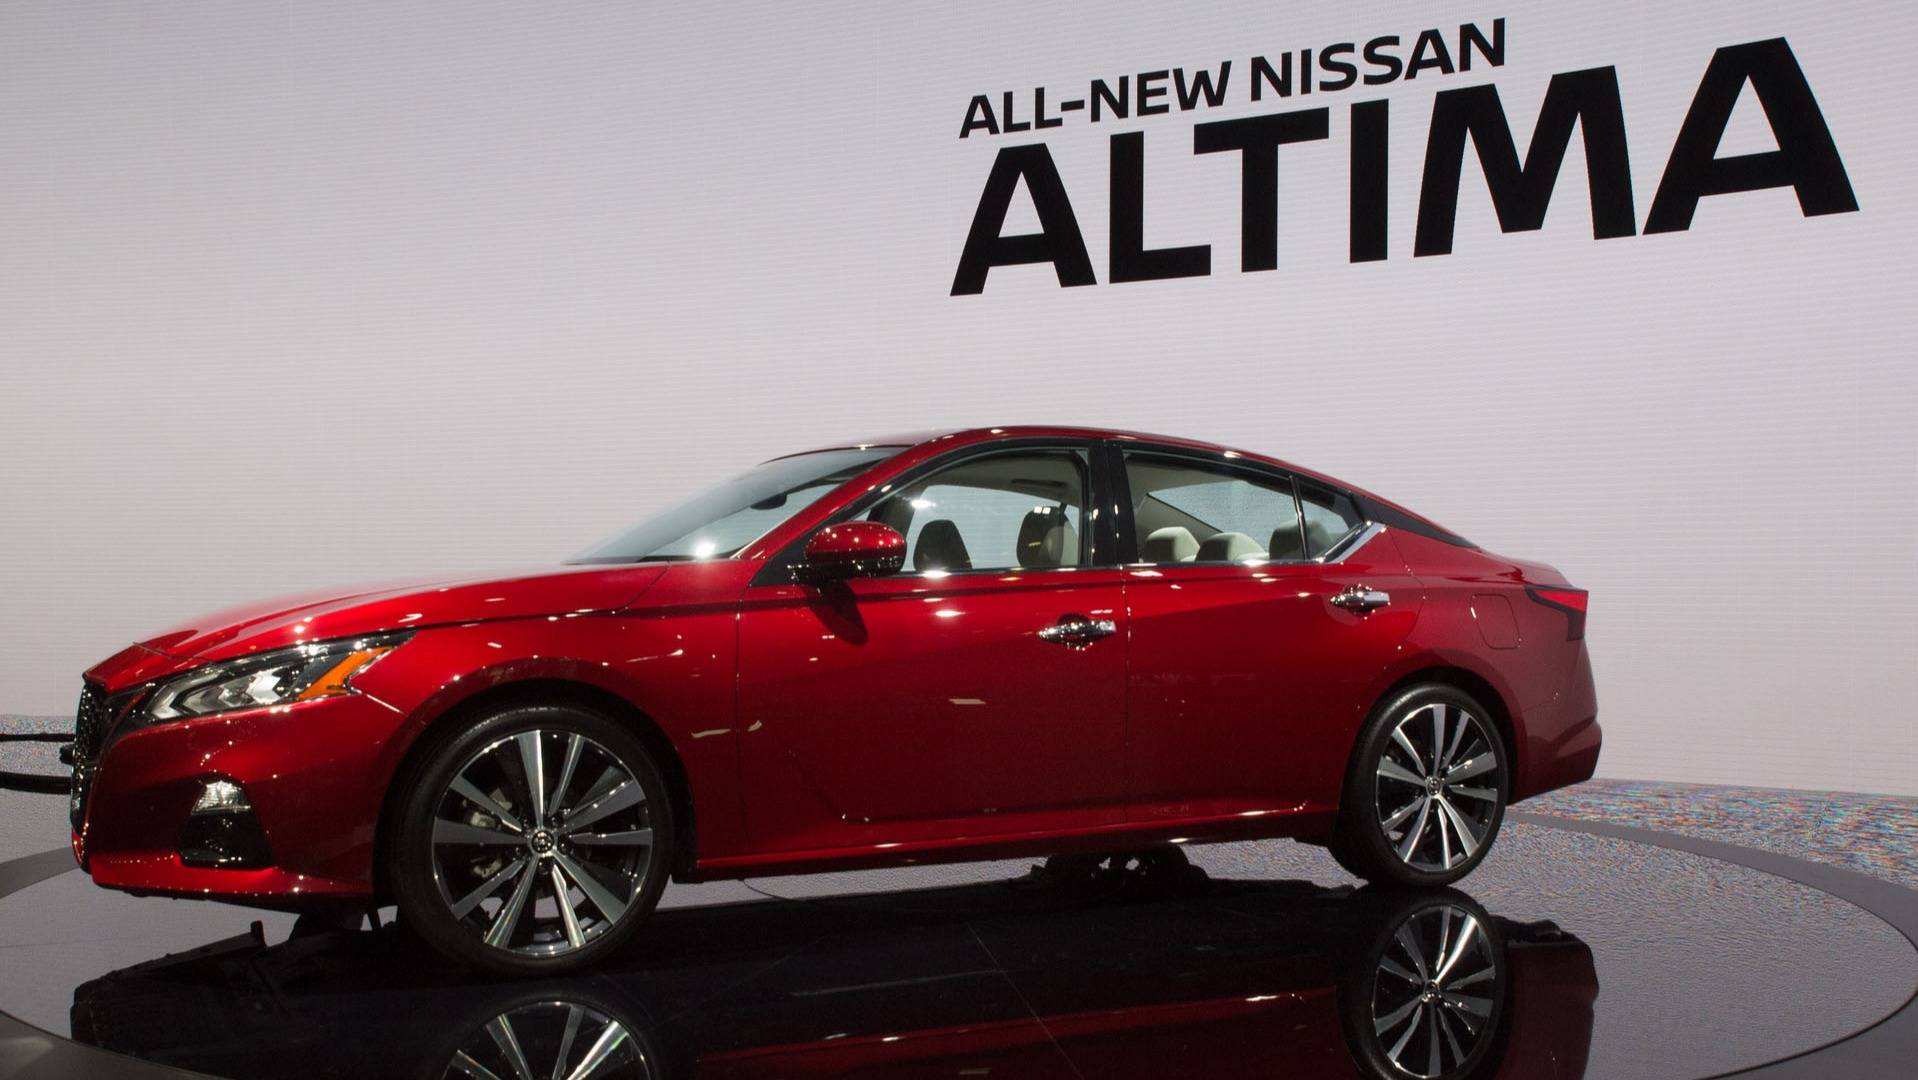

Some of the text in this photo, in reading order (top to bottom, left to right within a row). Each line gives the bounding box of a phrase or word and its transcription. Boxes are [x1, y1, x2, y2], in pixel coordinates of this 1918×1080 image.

[949, 36, 1860, 297] ALTIMA
[958, 17, 1506, 139] ALL-NEW NISSAN
